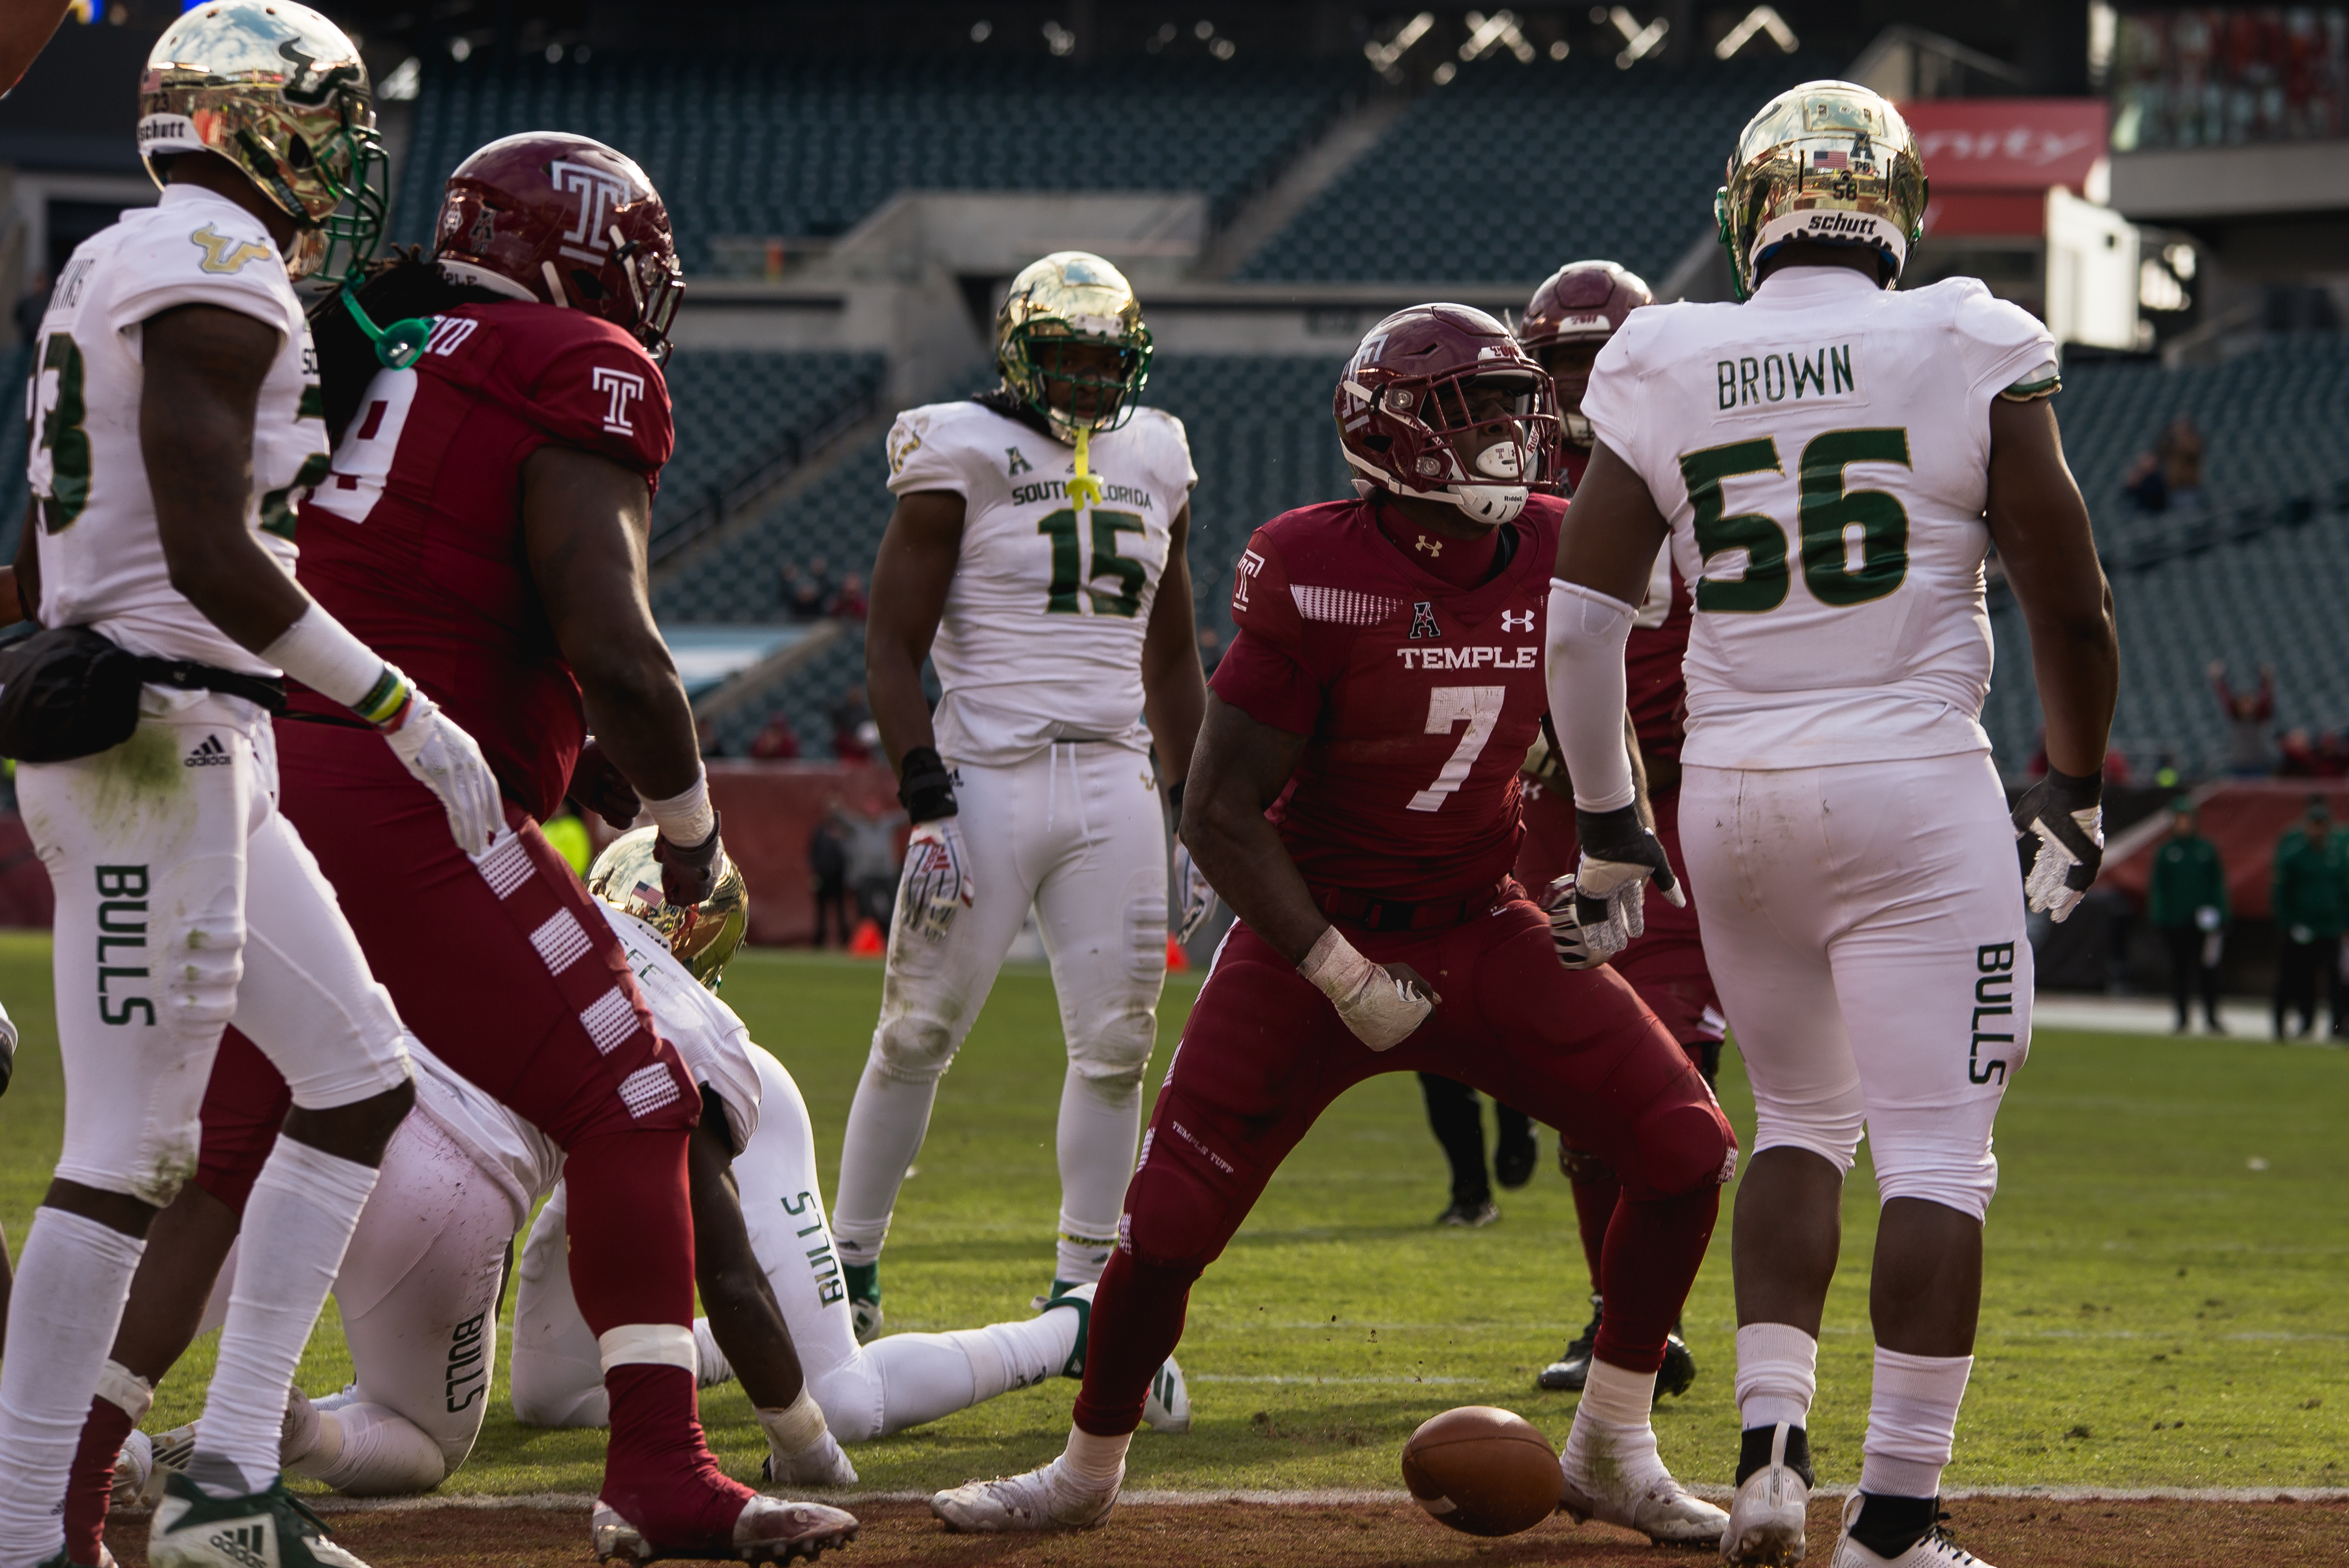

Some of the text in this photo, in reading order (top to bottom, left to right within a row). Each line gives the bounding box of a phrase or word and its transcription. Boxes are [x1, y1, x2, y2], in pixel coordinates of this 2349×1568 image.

[1807, 213, 1878, 236] schutt
[418, 315, 480, 358] YD
[1717, 343, 1855, 410] BROWN
[592, 366, 645, 437] T
[1037, 509, 1146, 619] 15
[1678, 427, 1913, 614] 56
[1397, 646, 1538, 669] TEMPLE
[1405, 685, 1506, 812] 7
[95, 865, 157, 1026] BULLS
[1969, 940, 2016, 1086] BULLS
[1173, 1120, 1234, 1173] TEMPLE TUFF
[781, 1191, 844, 1309] BULLS
[446, 1310, 487, 1413] BULLS
